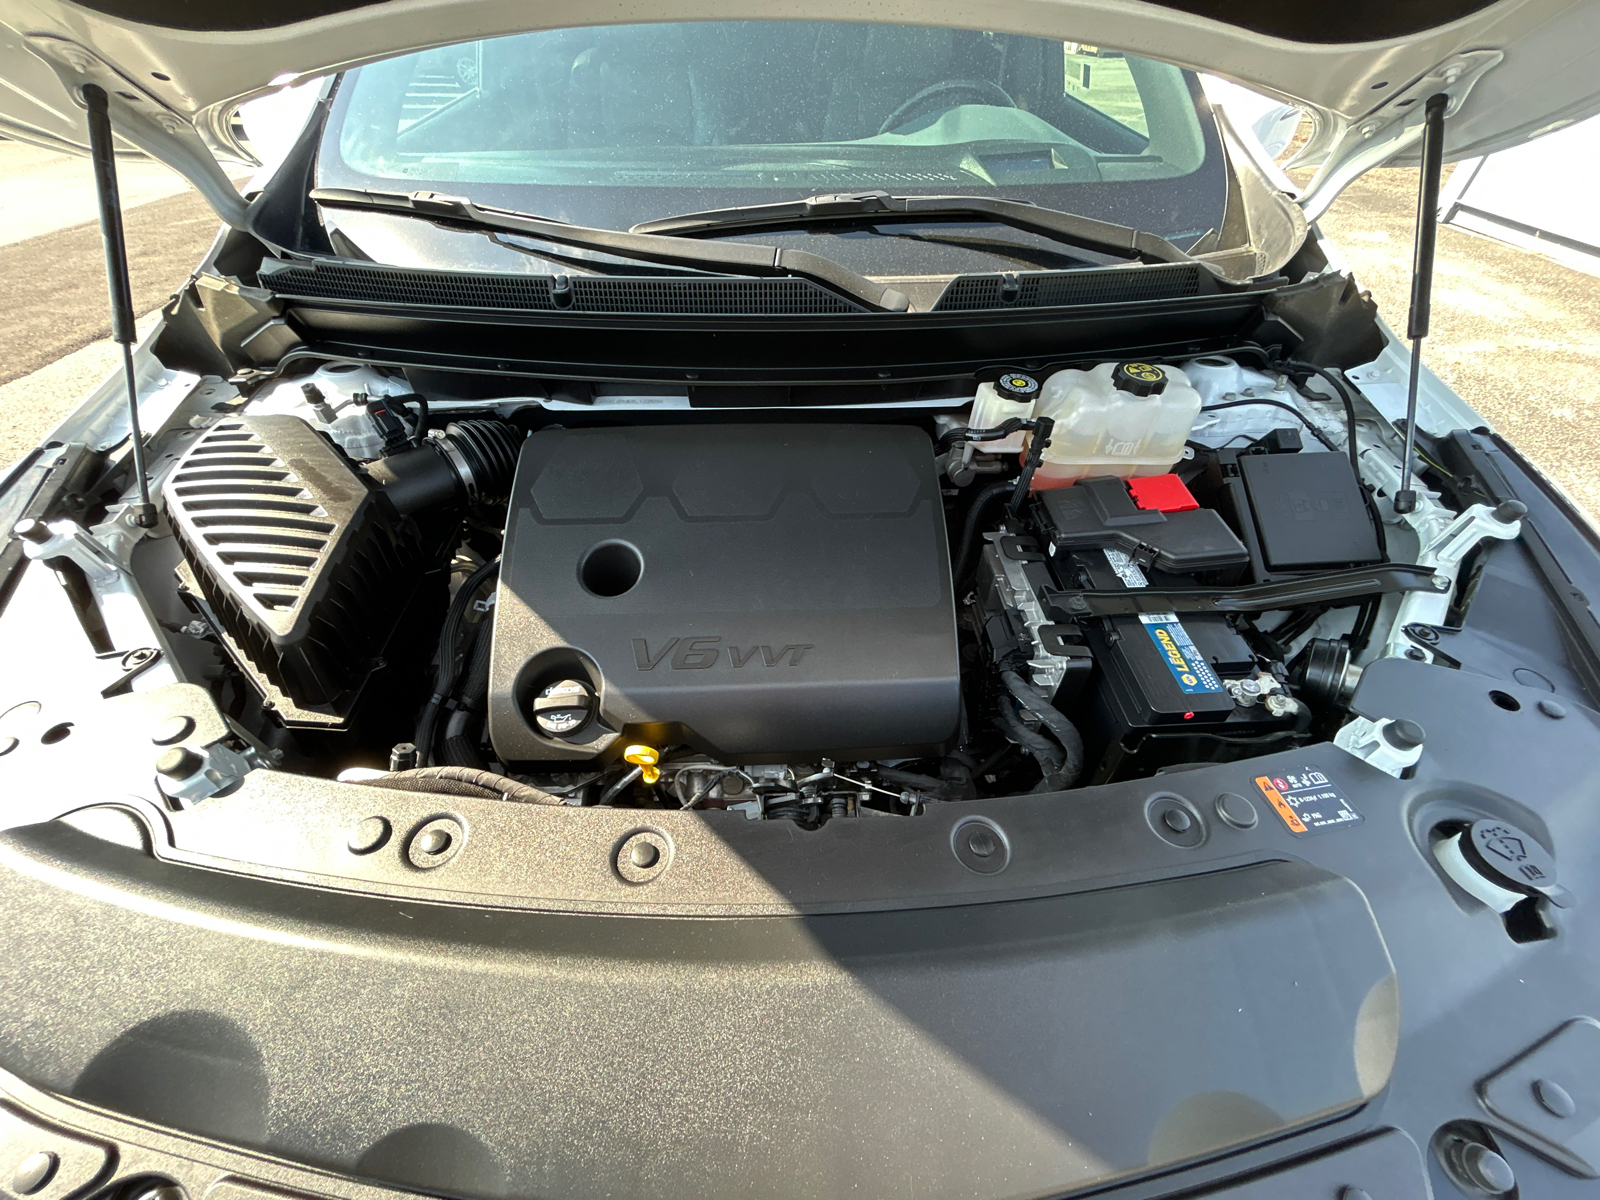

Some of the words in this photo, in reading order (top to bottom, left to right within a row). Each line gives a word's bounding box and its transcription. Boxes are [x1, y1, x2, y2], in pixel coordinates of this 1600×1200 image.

[631, 636, 721, 671] V6
[727, 644, 815, 668] VVT
[1155, 628, 1190, 672] LEGEND
